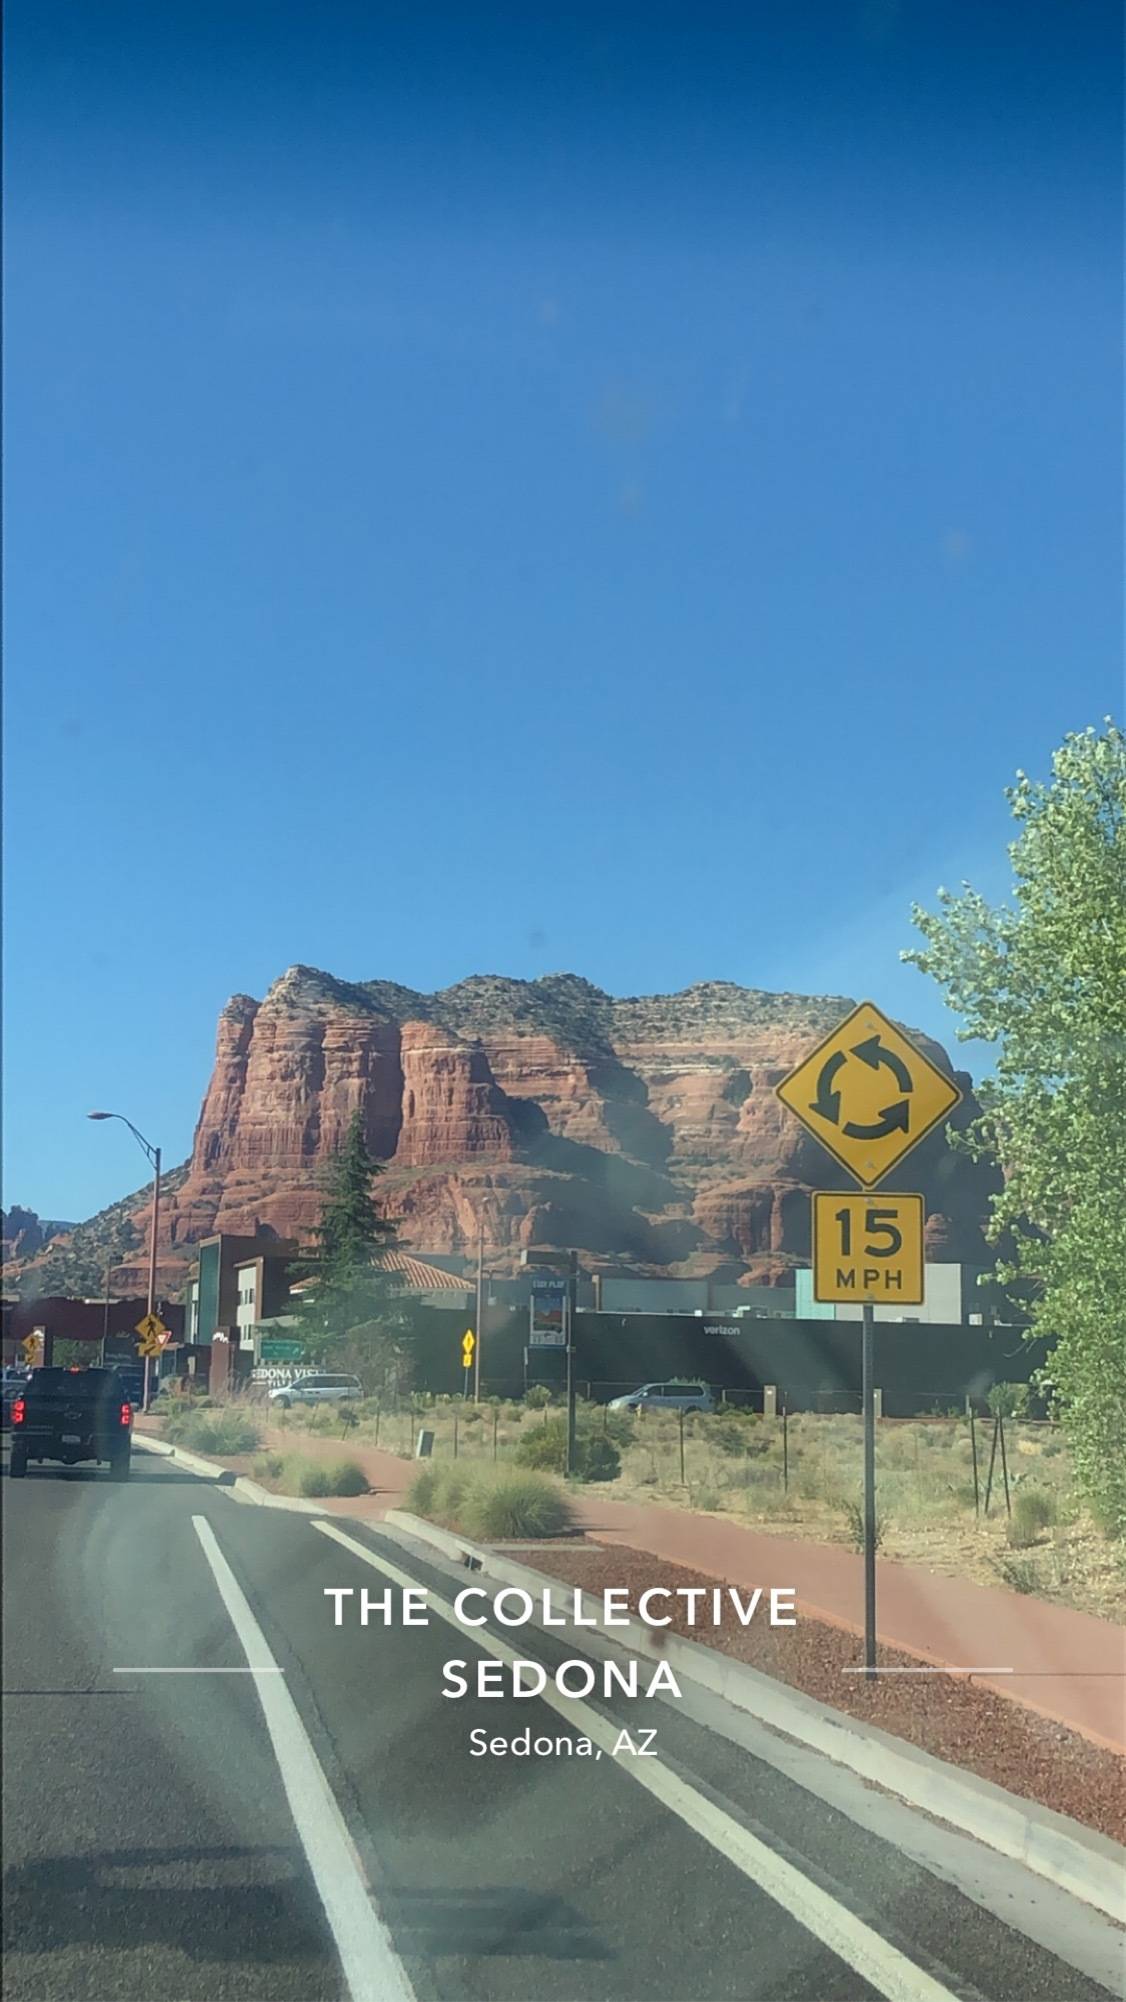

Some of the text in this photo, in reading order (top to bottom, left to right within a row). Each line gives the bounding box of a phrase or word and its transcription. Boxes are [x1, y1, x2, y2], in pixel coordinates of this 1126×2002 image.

[835, 1208, 902, 1258] 15
[836, 1268, 902, 1289] MPH
[703, 1325, 741, 1336] verizon
